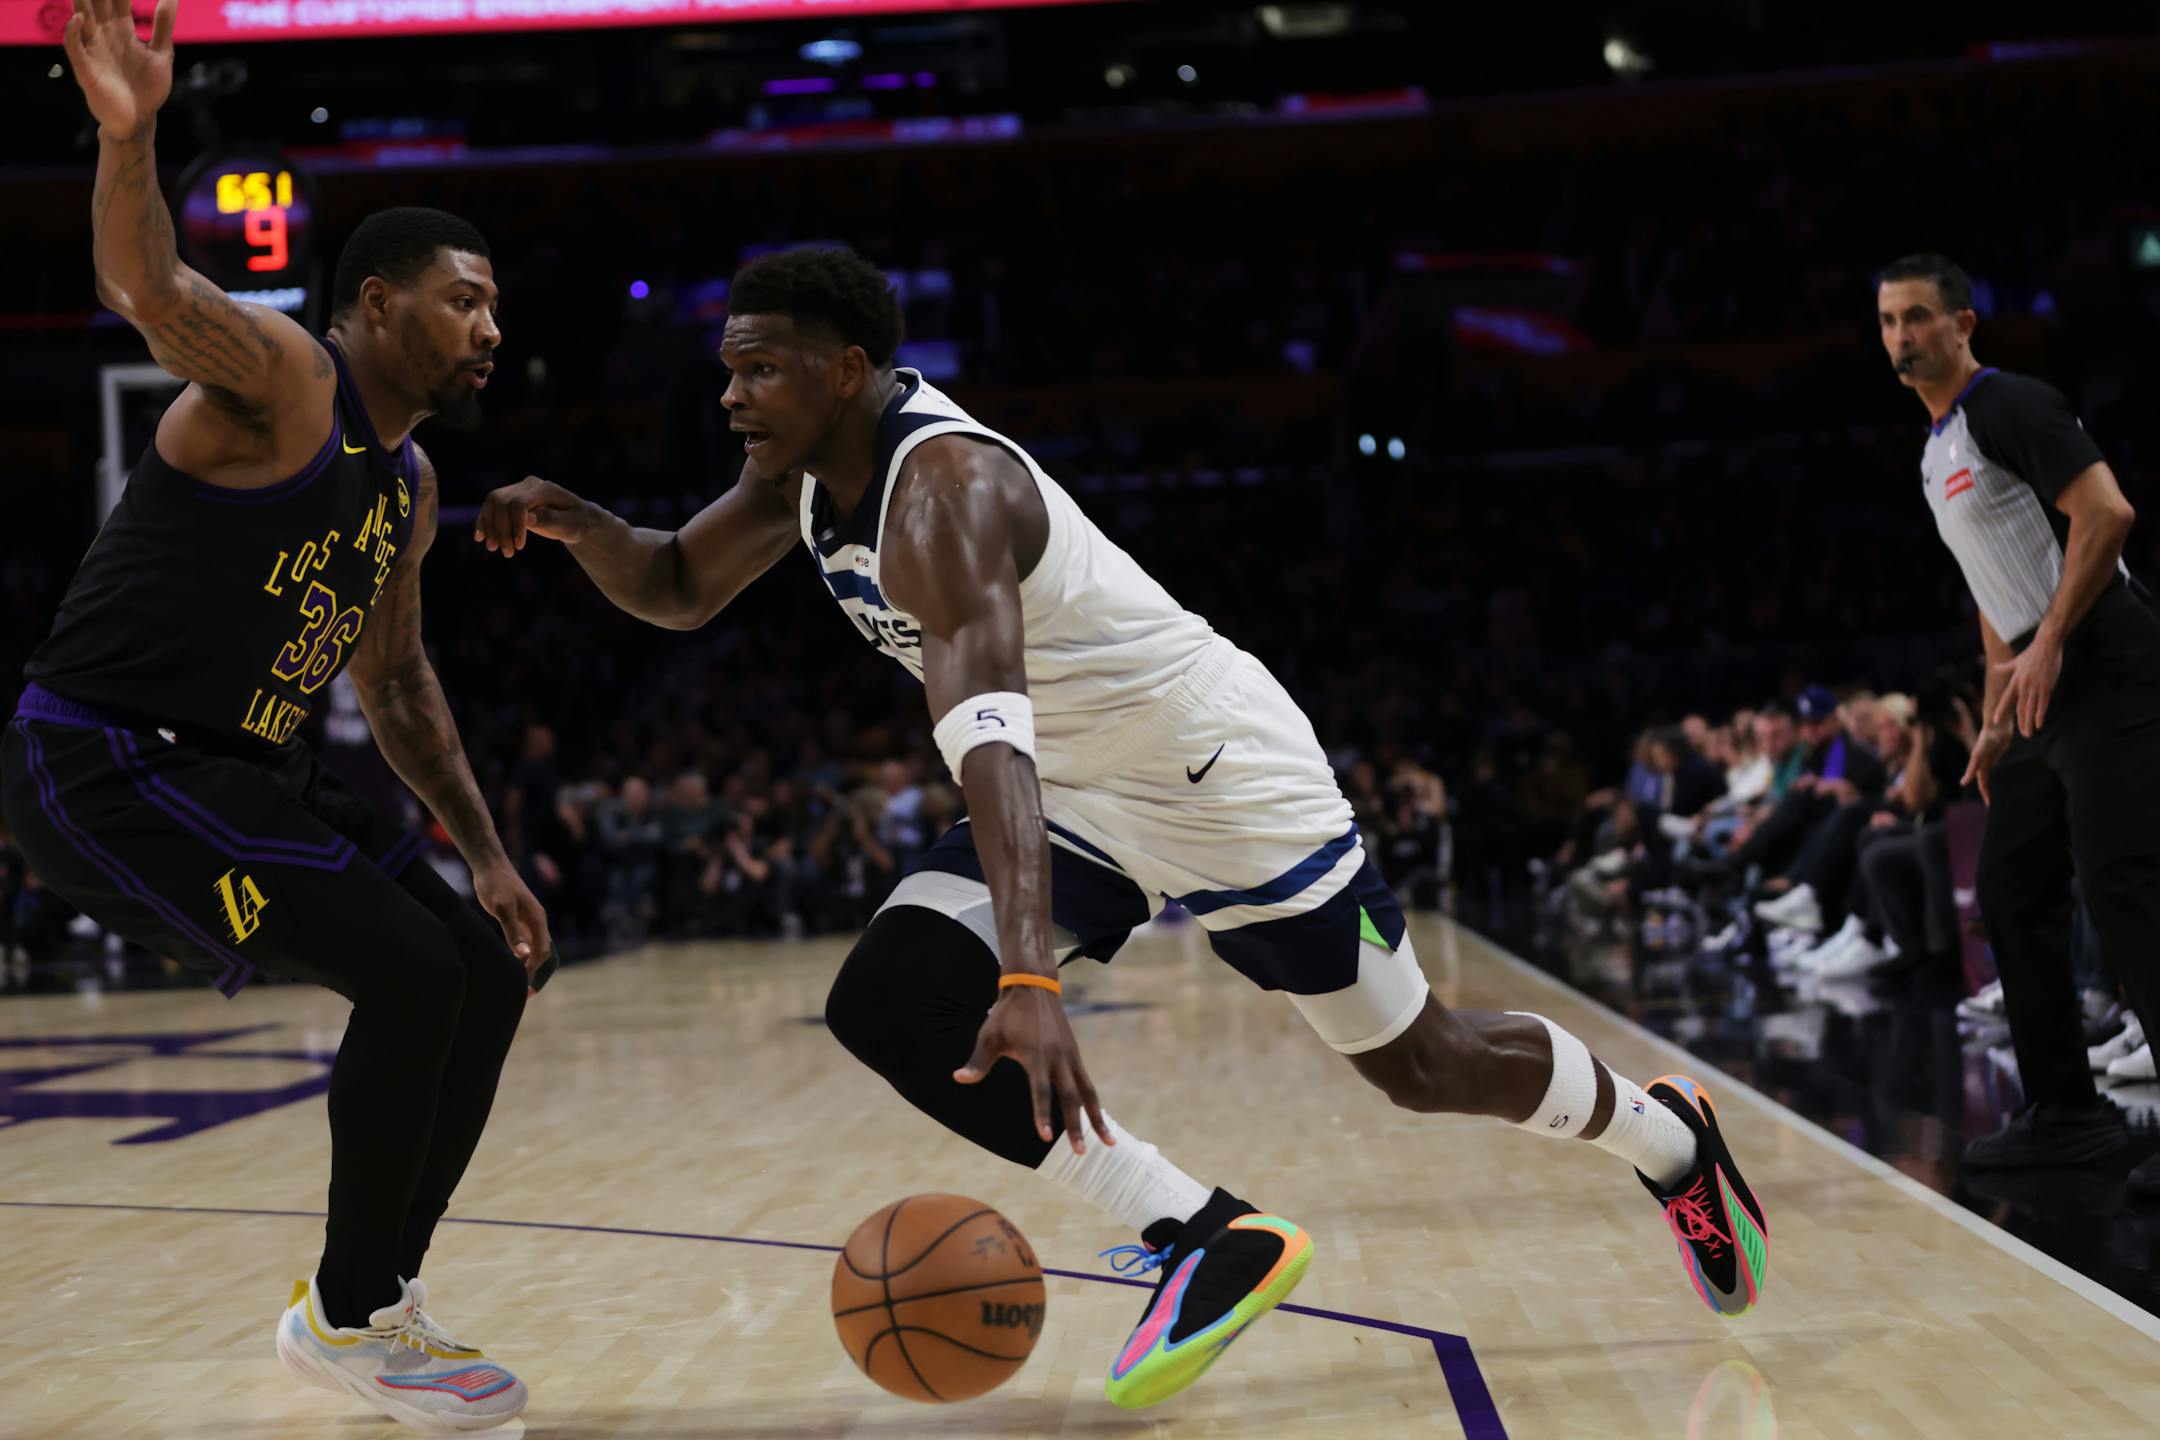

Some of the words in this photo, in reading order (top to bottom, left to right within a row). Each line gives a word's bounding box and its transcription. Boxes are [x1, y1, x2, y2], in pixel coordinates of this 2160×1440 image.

[245, 205, 289, 272] 9
[264, 529, 341, 597] LOS
[271, 579, 364, 694] 36
[976, 708, 1006, 730] 5
[213, 867, 271, 945] LA
